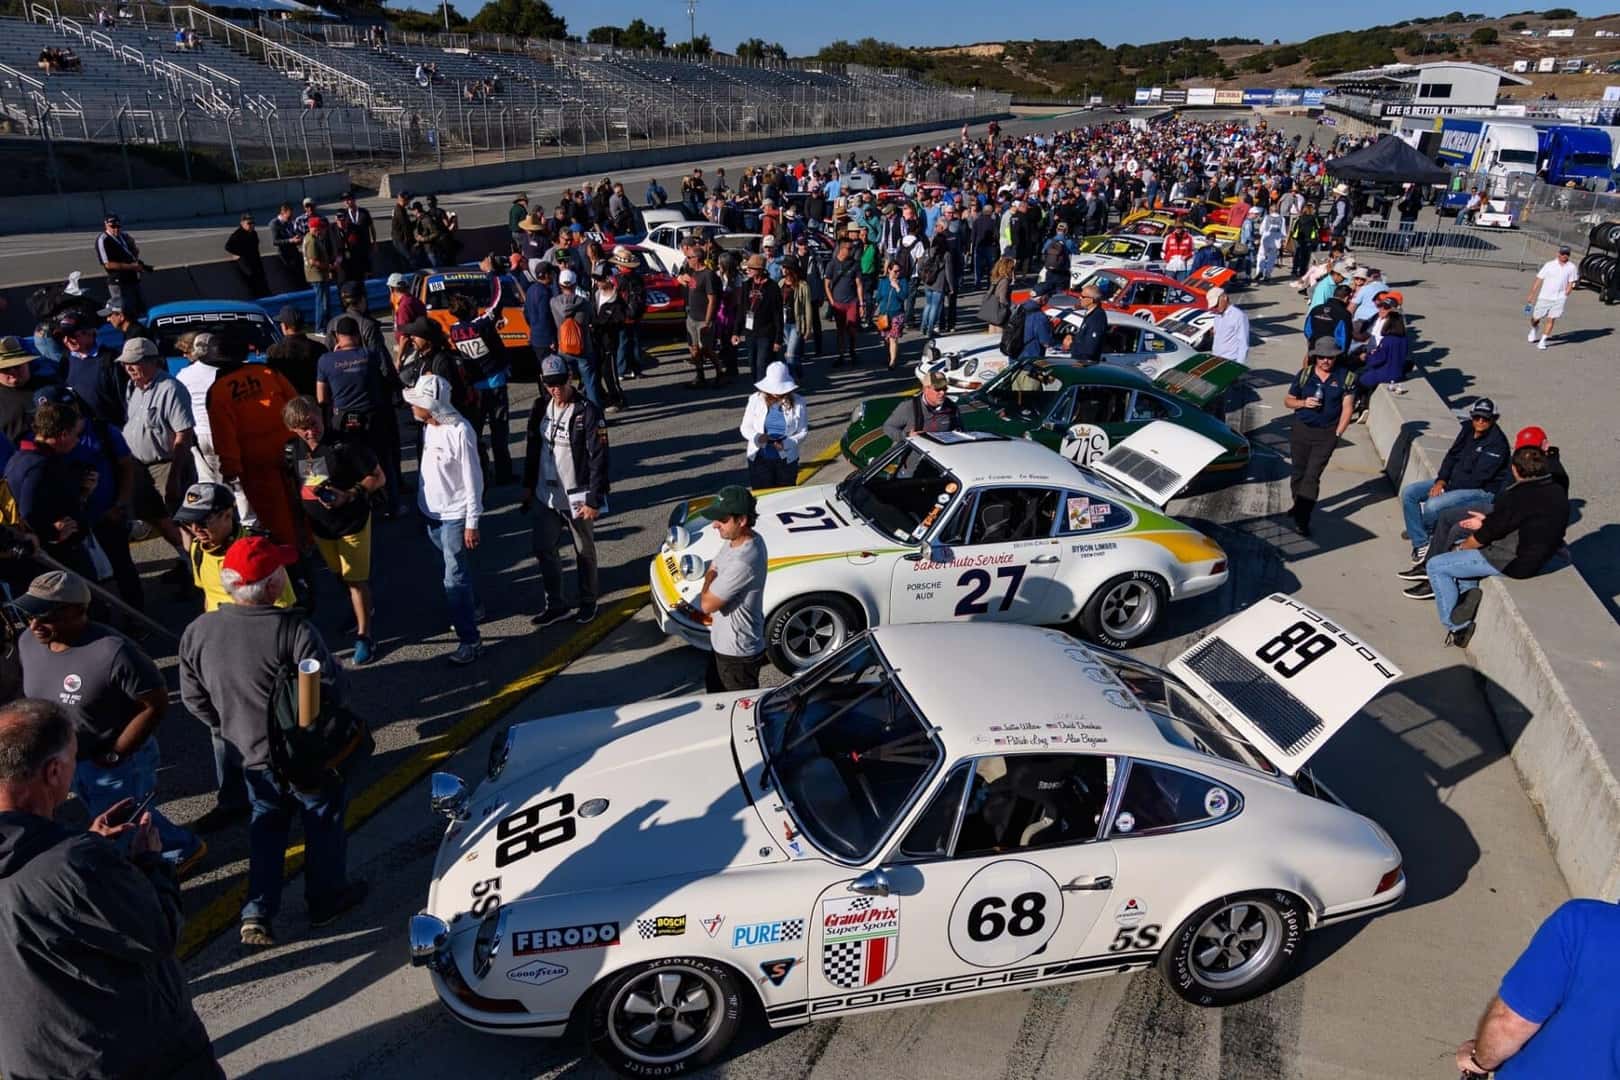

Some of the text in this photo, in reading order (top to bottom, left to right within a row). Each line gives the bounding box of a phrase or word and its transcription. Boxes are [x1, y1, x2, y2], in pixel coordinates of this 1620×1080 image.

[1386, 105, 1402, 115] LIFE
[1403, 105, 1411, 115] IS
[1412, 106, 1439, 116] BETTER
[1440, 129, 1481, 154] MICHELIN
[157, 312, 265, 328] PORSCHE
[776, 506, 839, 533] 27
[975, 552, 1014, 566] Service
[1072, 544, 1093, 553] BYRON
[906, 581, 942, 592] PORSCHE
[915, 592, 934, 601] AUDI
[954, 565, 1026, 616] 27
[1269, 594, 1396, 679] PORSCHE
[1255, 620, 1338, 679] 68
[496, 793, 576, 869] 68
[657, 917, 685, 928] BOSCH
[824, 907, 898, 927] Grand Prix
[826, 920, 897, 936] Super Sports
[967, 891, 1047, 942] 68
[516, 924, 616, 950] FERODO
[734, 923, 781, 946] PURE
[1108, 923, 1162, 951] 5S
[510, 967, 565, 979] GOODYEAR
[811, 967, 1039, 1012] PORSCHE
